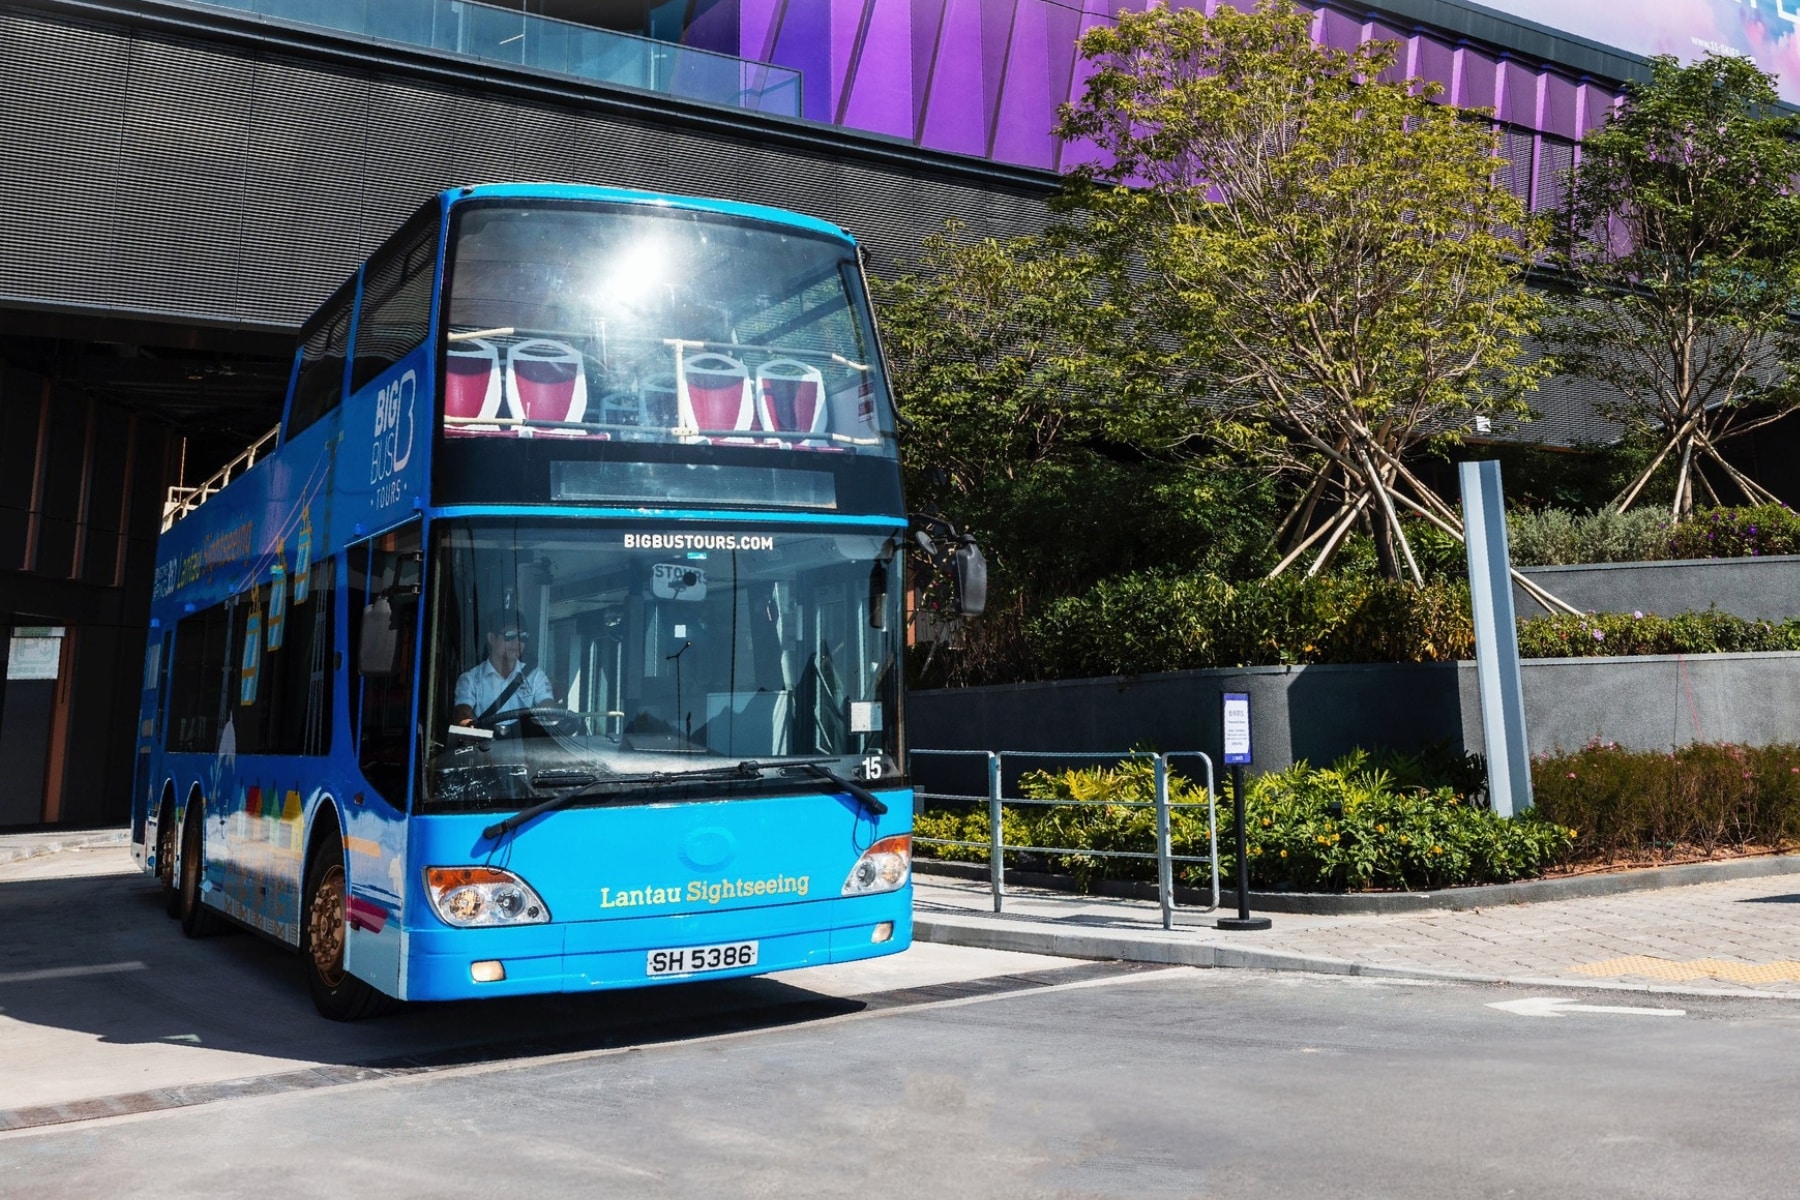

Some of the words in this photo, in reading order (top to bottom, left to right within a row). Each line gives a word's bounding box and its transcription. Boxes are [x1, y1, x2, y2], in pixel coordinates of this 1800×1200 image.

[374, 380, 398, 437] BIG
[370, 432, 394, 485] BUS
[376, 479, 401, 510] TOURS
[176, 547, 203, 589] Lantau
[202, 513, 254, 585] Sightseeing
[623, 533, 774, 550] BIGBUSTOURS.COM
[862, 756, 882, 780] 15
[600, 885, 681, 908] Lantau
[687, 874, 810, 904] Sightseeing
[652, 951, 684, 973] SH
[691, 945, 752, 969] 5386
